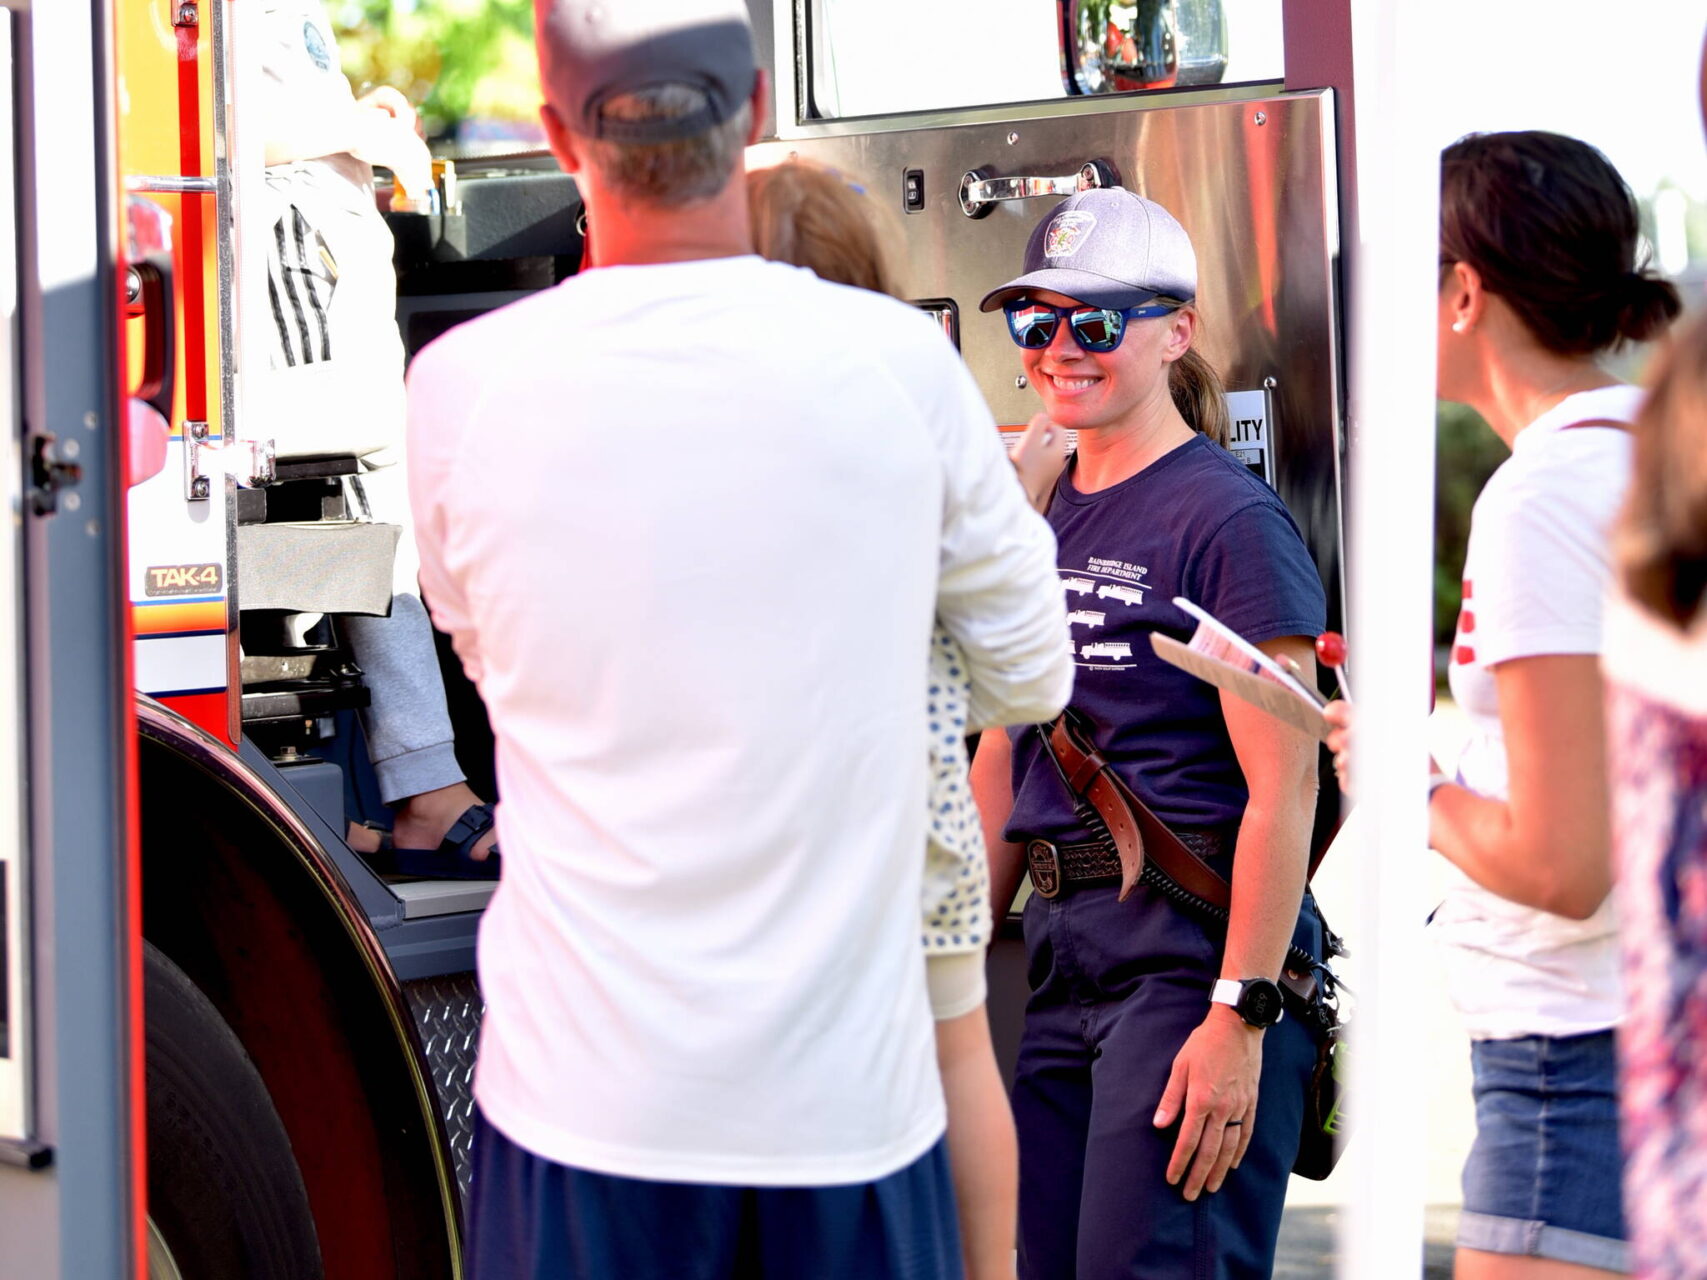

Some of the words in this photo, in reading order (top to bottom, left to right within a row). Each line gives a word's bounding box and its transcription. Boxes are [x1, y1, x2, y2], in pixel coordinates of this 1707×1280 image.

[150, 566, 218, 588] TAK-4
[1087, 564, 1101, 573] FIRE
[1100, 566, 1142, 581] DEPARTMENT
[1123, 562, 1148, 575] ISLAND
